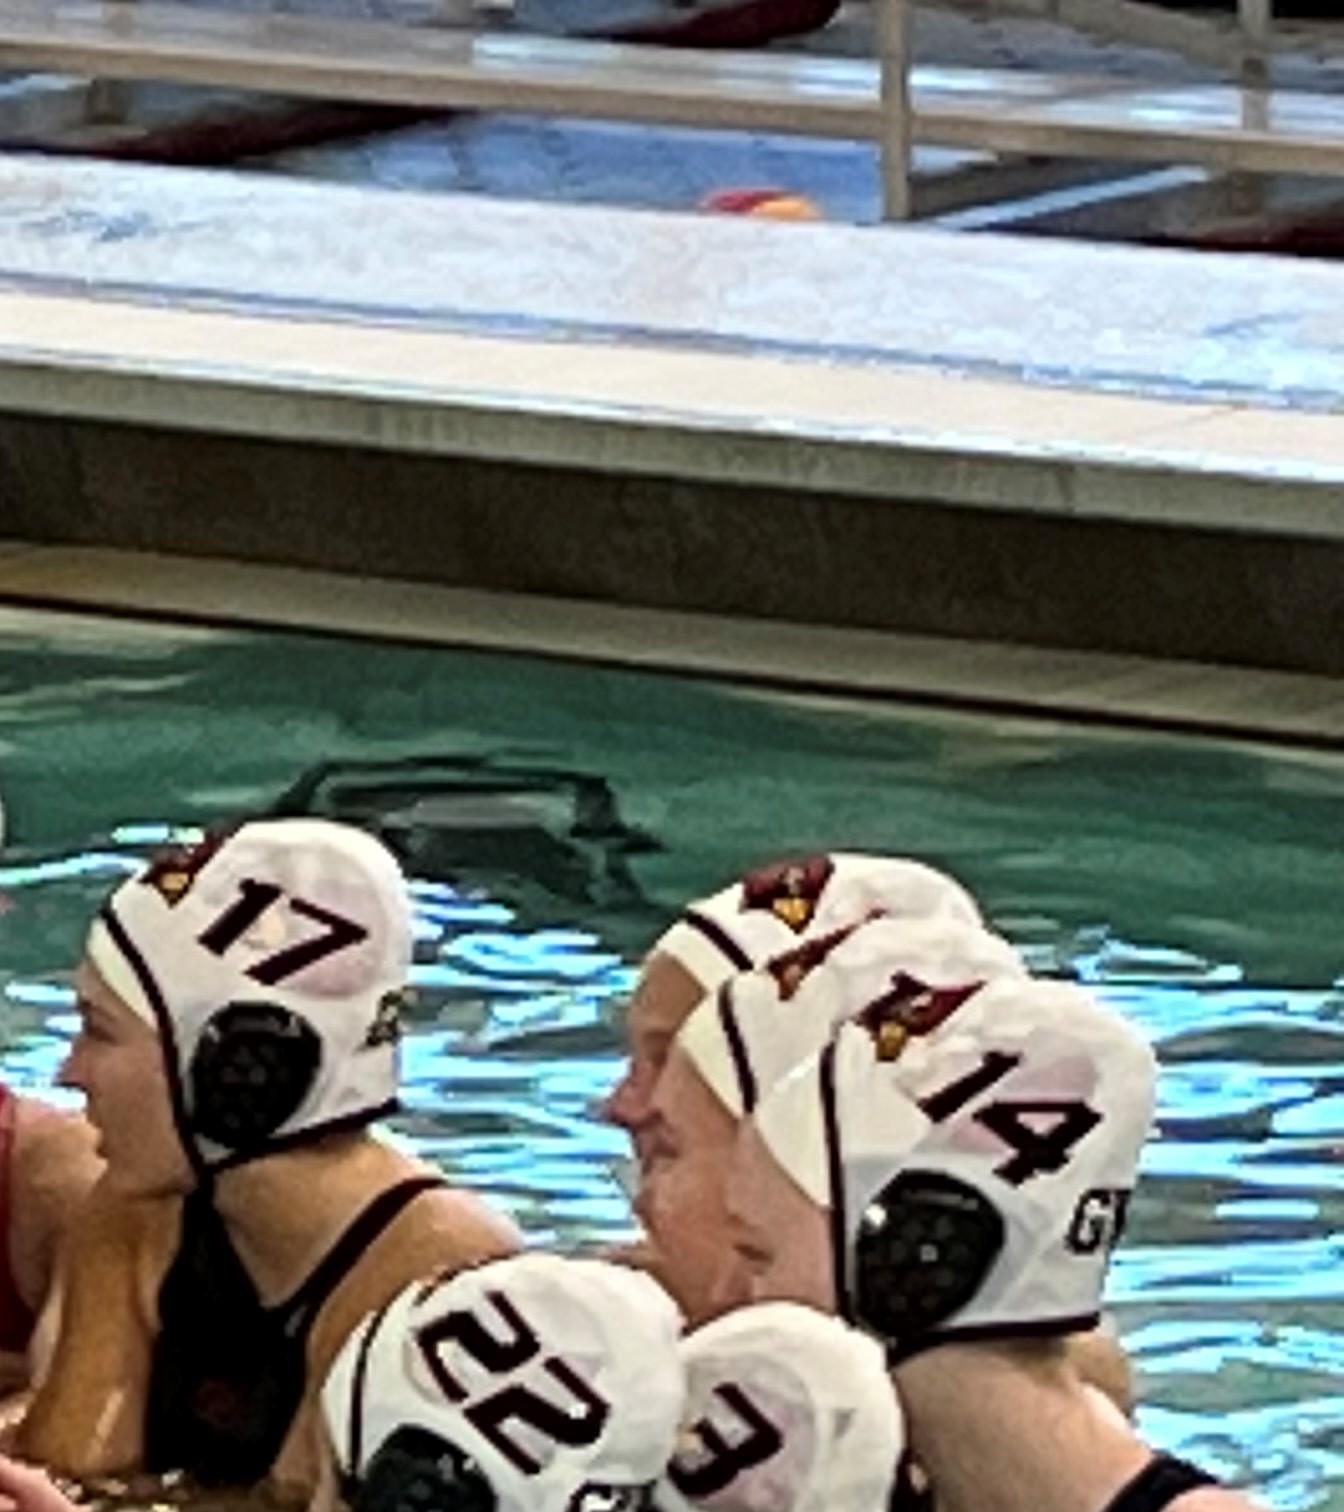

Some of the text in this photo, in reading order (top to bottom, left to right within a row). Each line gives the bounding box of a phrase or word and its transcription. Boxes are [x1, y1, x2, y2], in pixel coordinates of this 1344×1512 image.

[198, 879, 368, 986] 17
[916, 1052, 1102, 1187] 14
[417, 1290, 609, 1476] 22
[666, 1382, 783, 1499] 3
